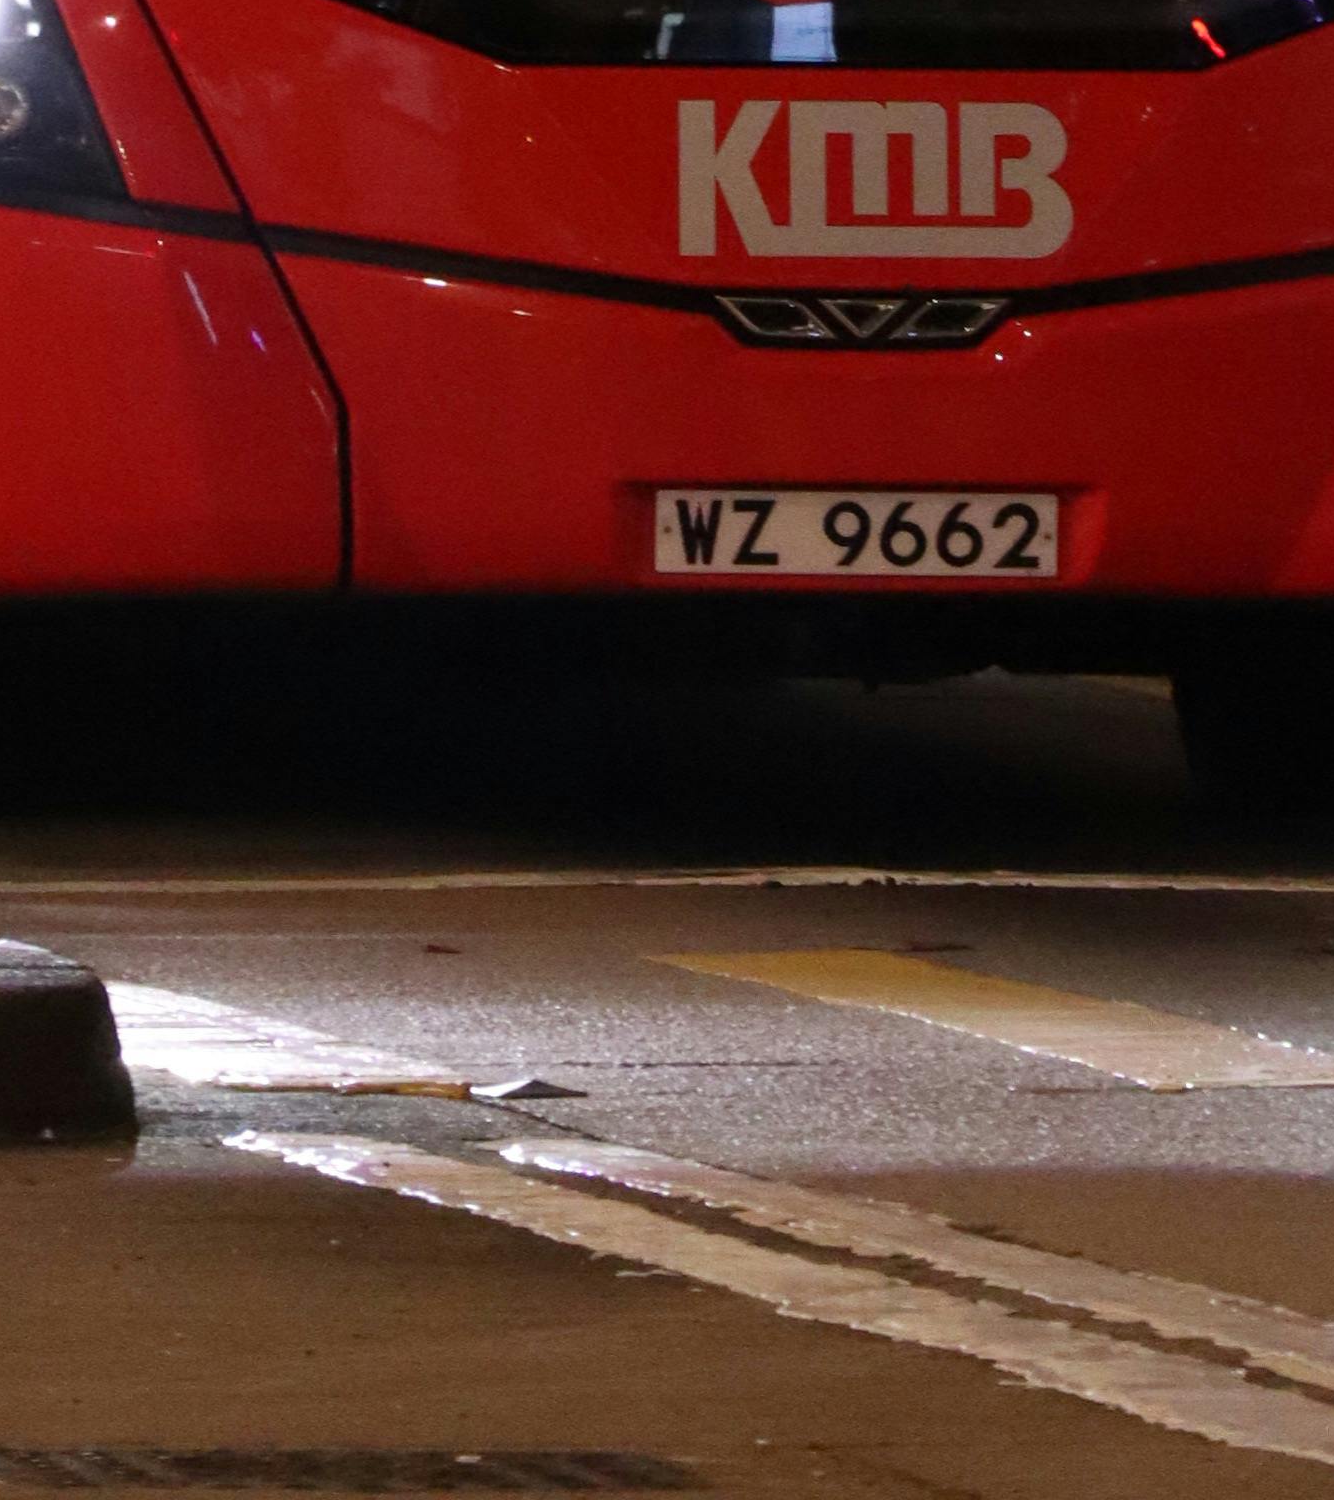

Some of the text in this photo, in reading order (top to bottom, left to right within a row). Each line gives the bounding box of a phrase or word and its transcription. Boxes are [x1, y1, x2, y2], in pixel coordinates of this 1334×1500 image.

[677, 99, 1074, 259] KMB
[675, 498, 1041, 568] WZ 9662
